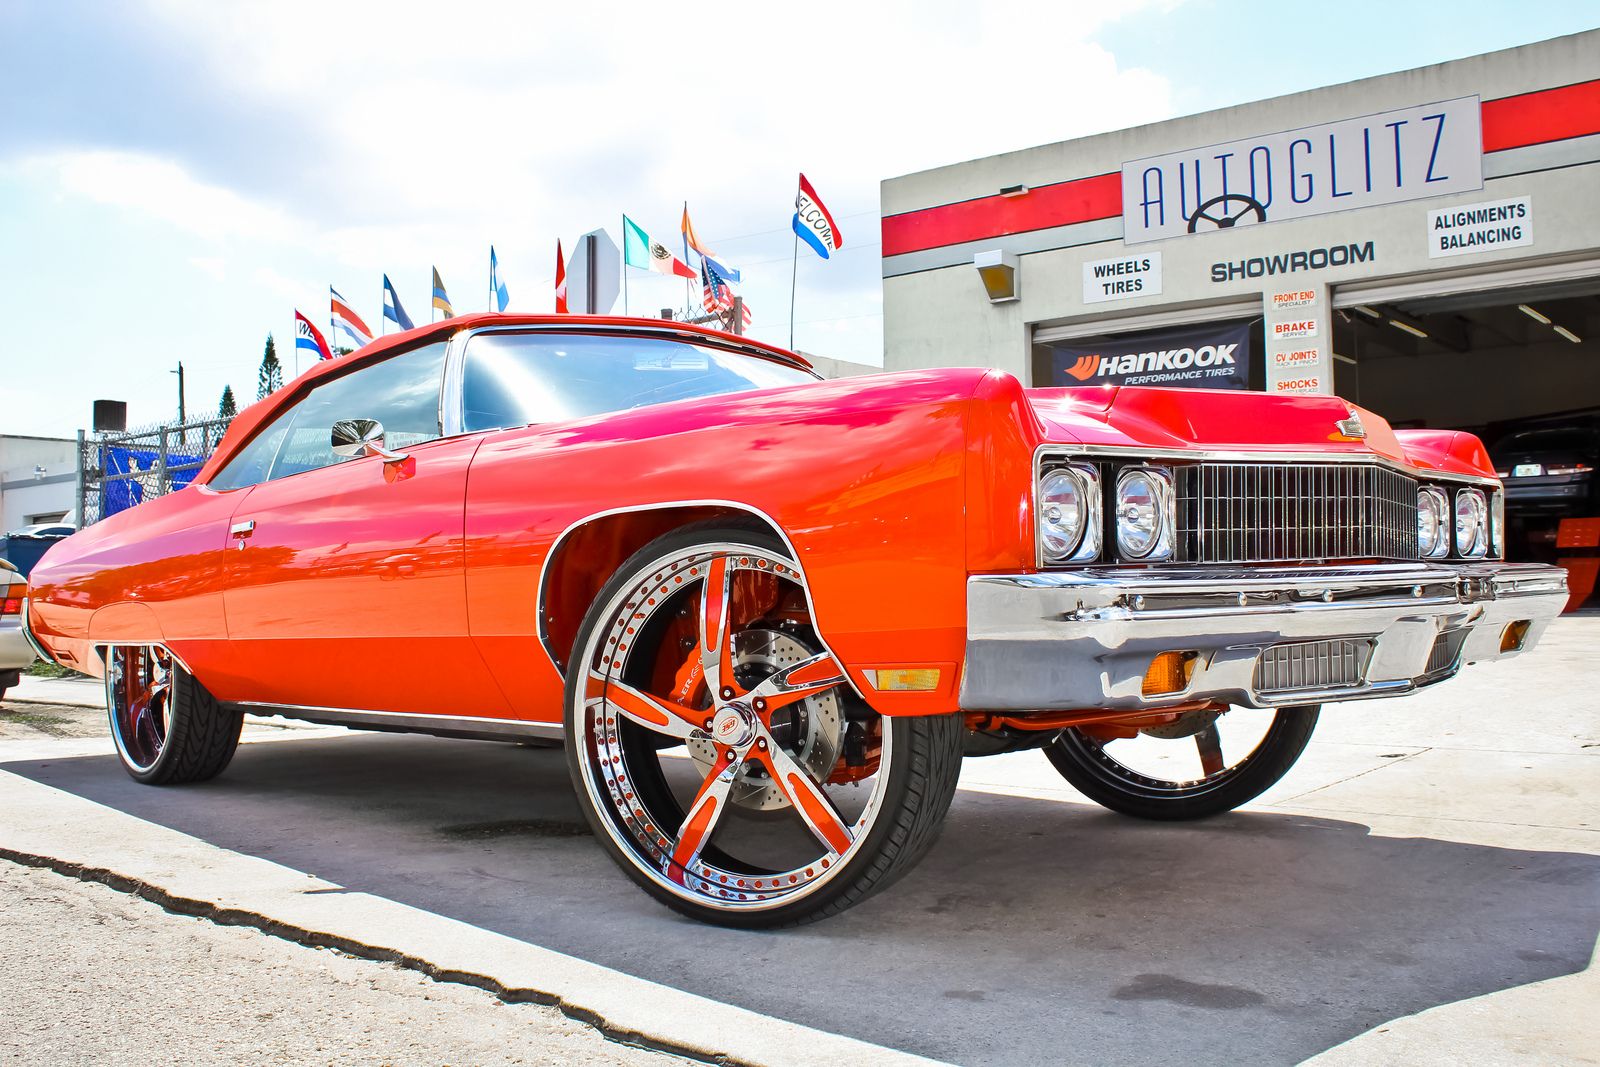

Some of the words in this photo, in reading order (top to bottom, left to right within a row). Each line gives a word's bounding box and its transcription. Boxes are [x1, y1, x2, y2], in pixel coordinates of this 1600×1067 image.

[1140, 113, 1448, 228] AUTOGLITZ
[795, 194, 834, 252] ELCOME
[1434, 203, 1526, 230] ALIGNMENTS
[1440, 225, 1522, 250] BALANCING
[1094, 259, 1151, 278] WHEELS
[1211, 241, 1375, 283] SHOWROOM
[1102, 278, 1143, 295] TIRES
[1273, 292, 1298, 303] FRONT
[1300, 290, 1315, 301] END
[1278, 300, 1311, 308] SPECIALIST
[1275, 321, 1315, 333] BRAKE
[1282, 330, 1308, 338] SERVICE
[1275, 353, 1287, 362] CV
[1289, 350, 1317, 361] JOINTS
[1125, 370, 1202, 385] PERFORMANCE
[1205, 367, 1235, 377] TIRES
[1277, 378, 1318, 391] SHOCKS
